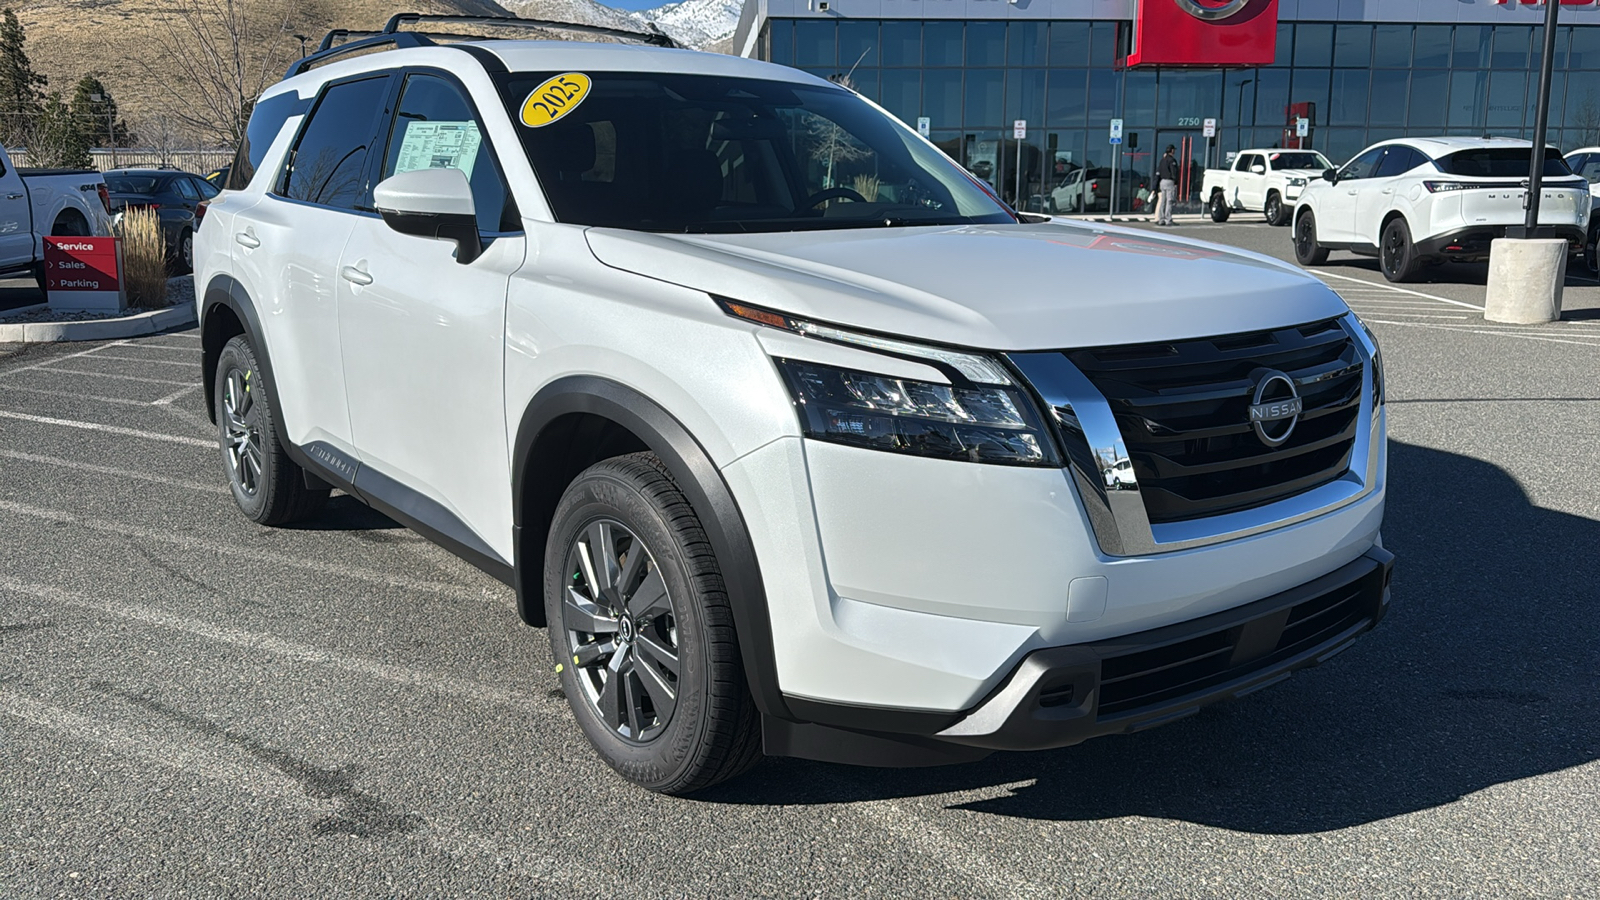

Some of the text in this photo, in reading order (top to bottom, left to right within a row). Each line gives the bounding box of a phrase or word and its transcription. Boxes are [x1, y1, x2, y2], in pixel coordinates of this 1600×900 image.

[532, 77, 581, 119] 2025
[1178, 117, 1200, 126] 2750
[57, 242, 94, 251] Service
[59, 261, 86, 269] Sales
[60, 279, 99, 289] Parking
[1252, 401, 1302, 419] NISSAN
